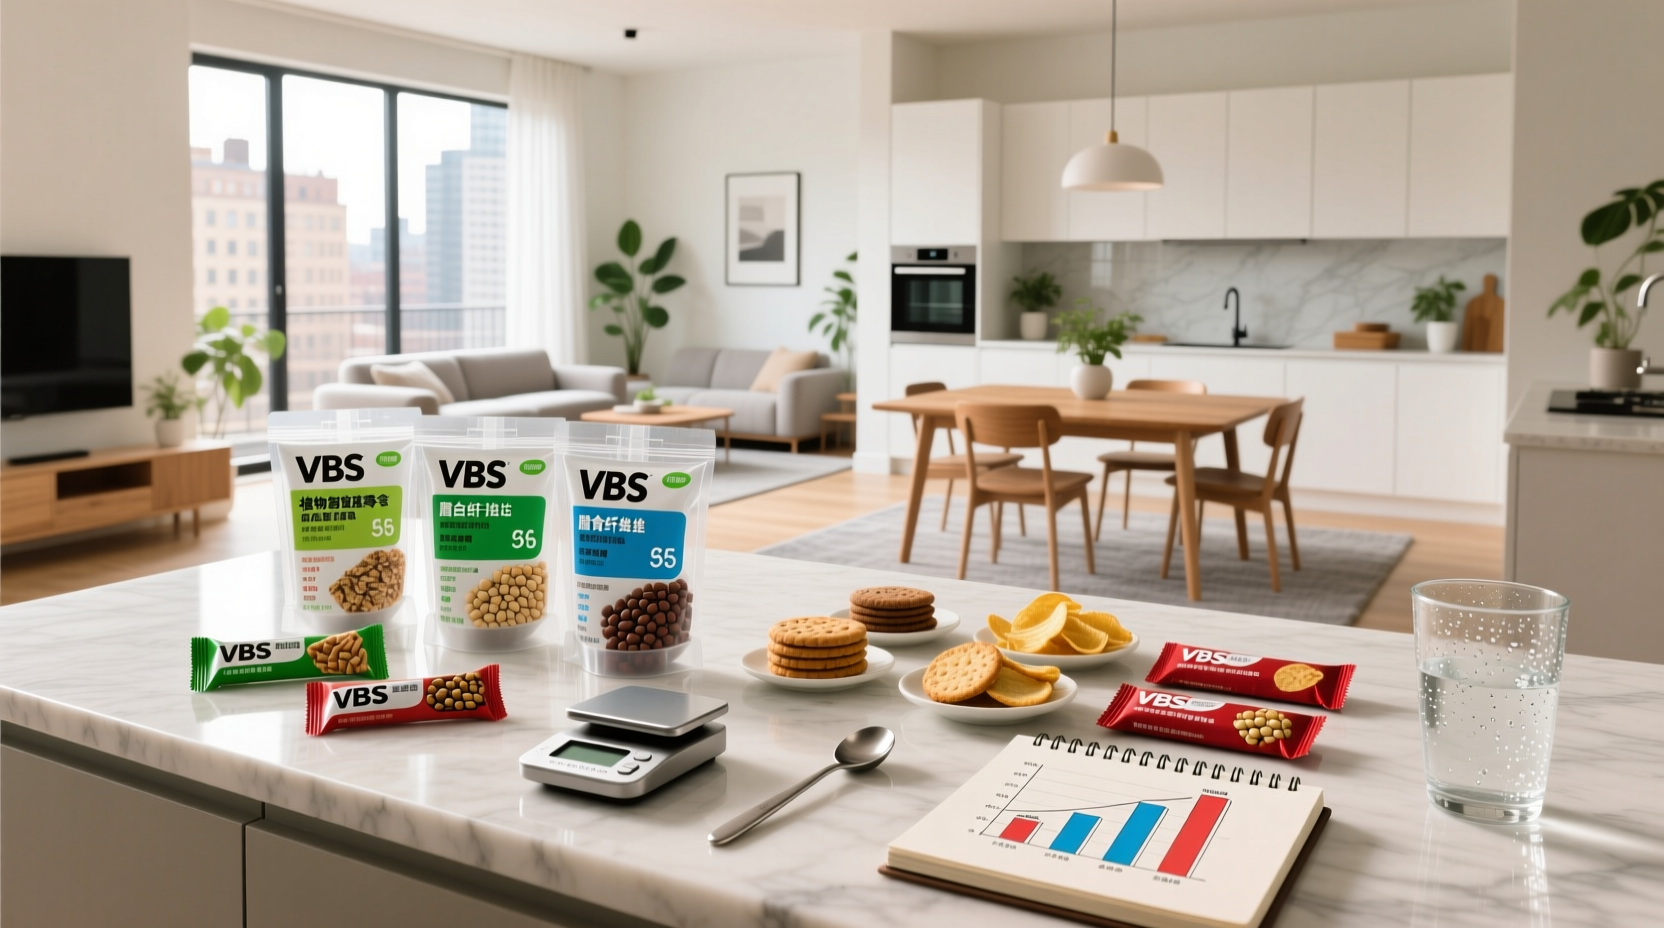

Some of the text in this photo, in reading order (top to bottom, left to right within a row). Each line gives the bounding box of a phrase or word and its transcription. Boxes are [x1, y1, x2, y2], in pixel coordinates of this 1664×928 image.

[295, 453, 365, 484] VBS
[438, 459, 507, 489] VBS
[579, 469, 649, 503] VBS
[219, 642, 272, 663] VBS
[1182, 648, 1230, 665] VBS
[332, 685, 389, 709] VBS
[1139, 690, 1191, 709] VBS
